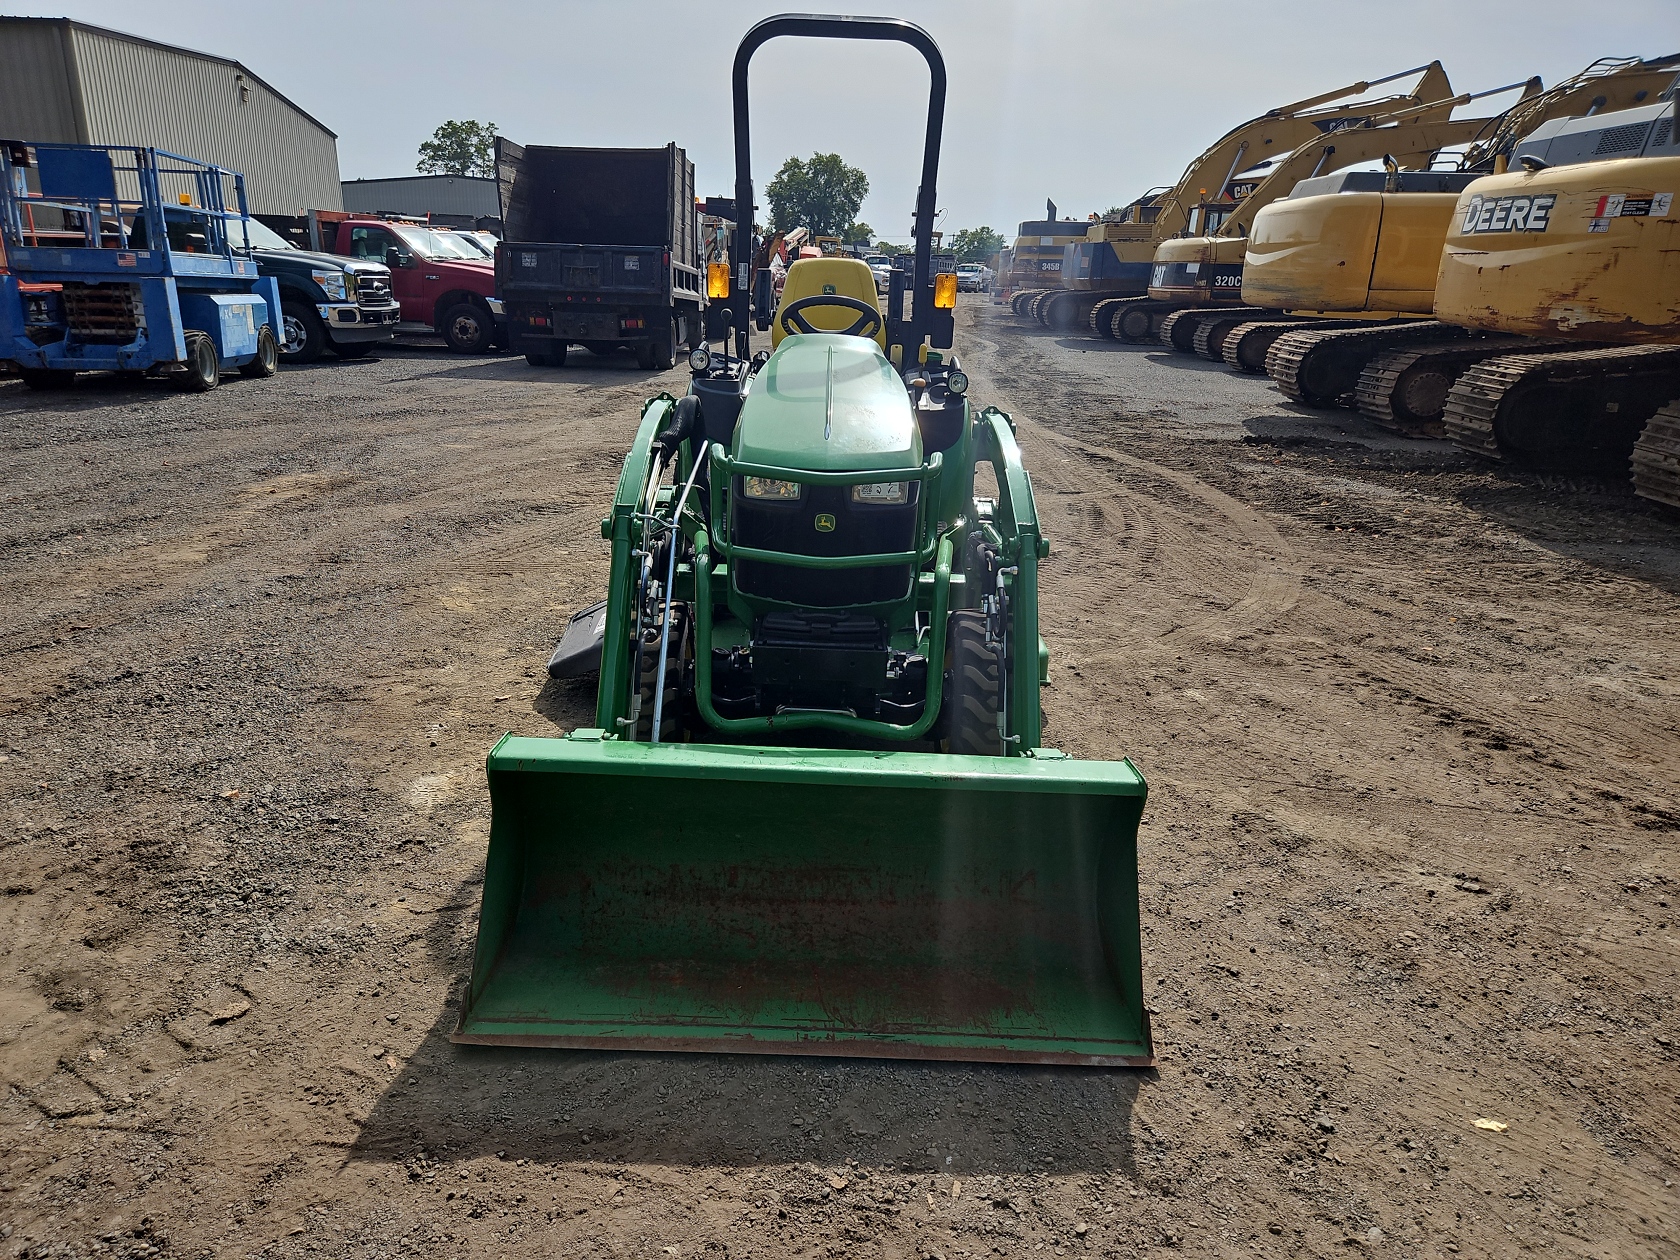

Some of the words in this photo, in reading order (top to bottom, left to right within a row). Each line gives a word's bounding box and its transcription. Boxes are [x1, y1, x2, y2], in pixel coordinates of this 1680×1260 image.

[1234, 184, 1253, 199] CAT
[1461, 194, 1557, 235] DEERE
[1041, 262, 1060, 271] 345B
[1152, 265, 1167, 288] CAT
[1214, 275, 1242, 287] 320C
